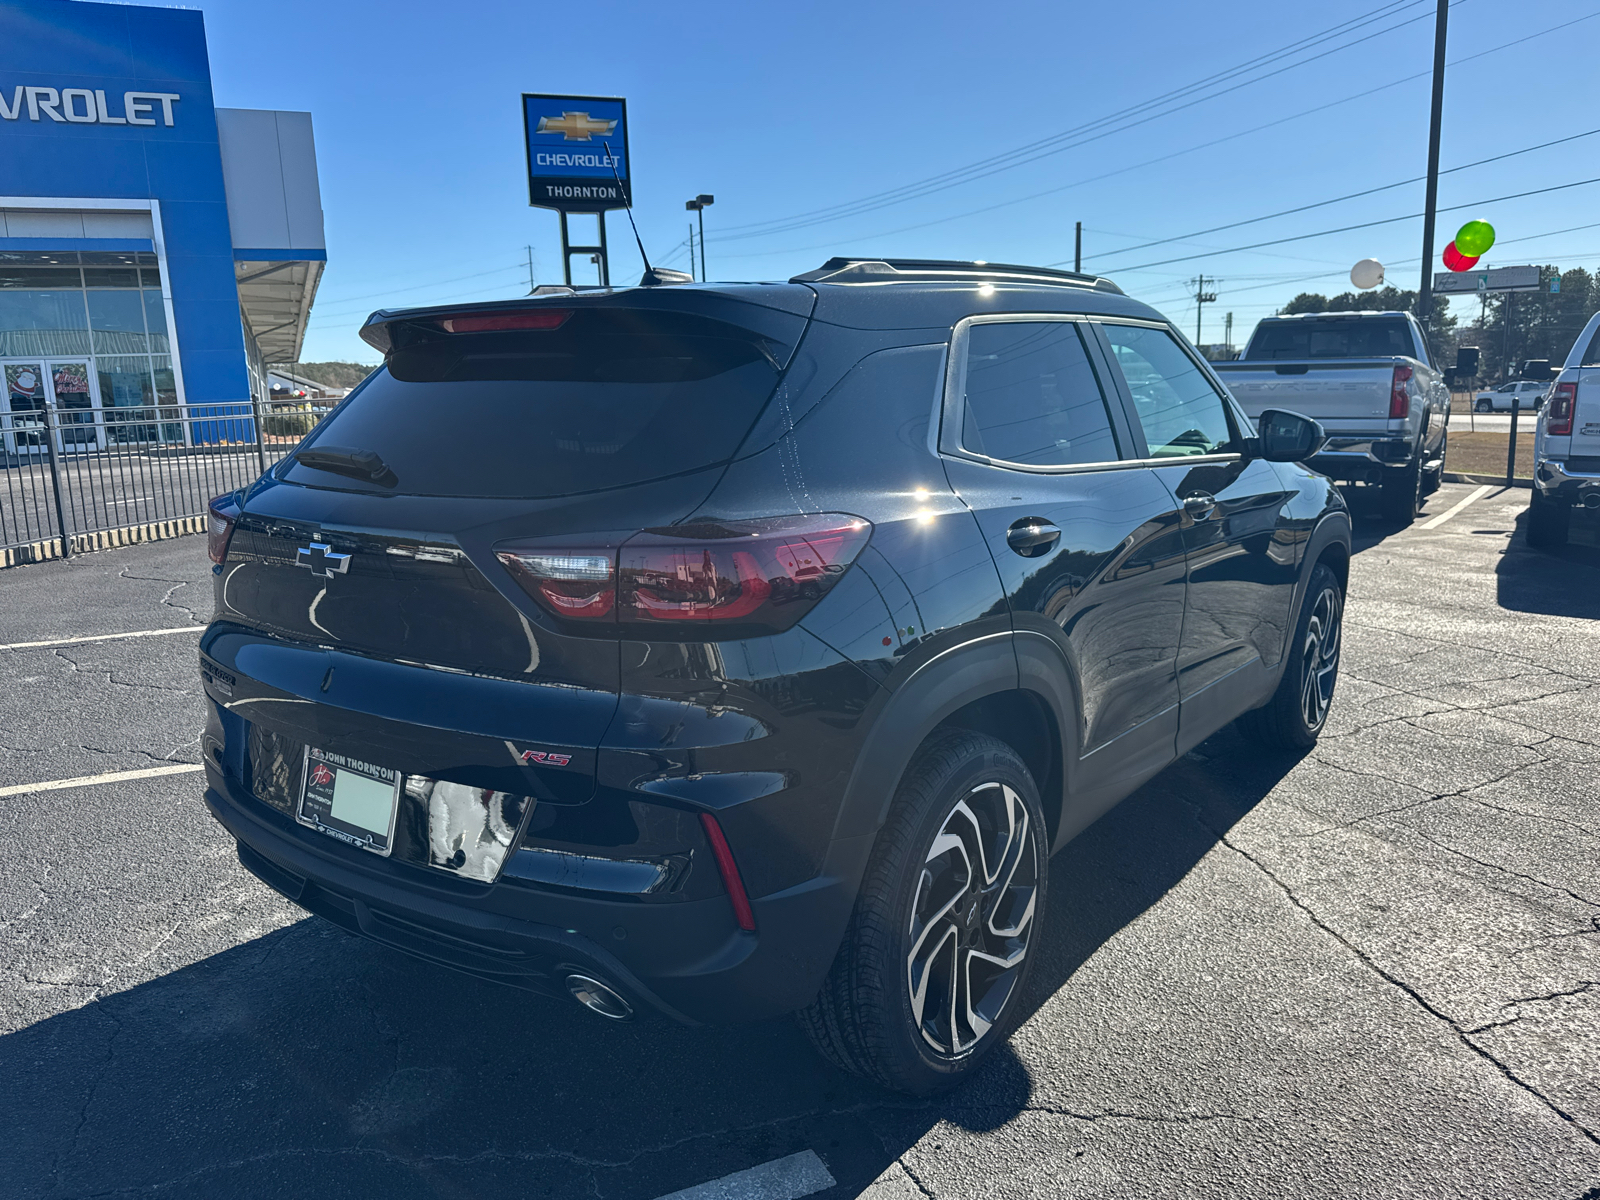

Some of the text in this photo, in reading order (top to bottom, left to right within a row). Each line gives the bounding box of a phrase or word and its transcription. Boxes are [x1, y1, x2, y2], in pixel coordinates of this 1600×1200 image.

[537, 153, 620, 168] CHEVROLET
[546, 185, 616, 198] THORNTON
[324, 751, 394, 780] JOHN THORNTON
[520, 749, 572, 766] RS
[326, 828, 353, 844] CHEVROLET
